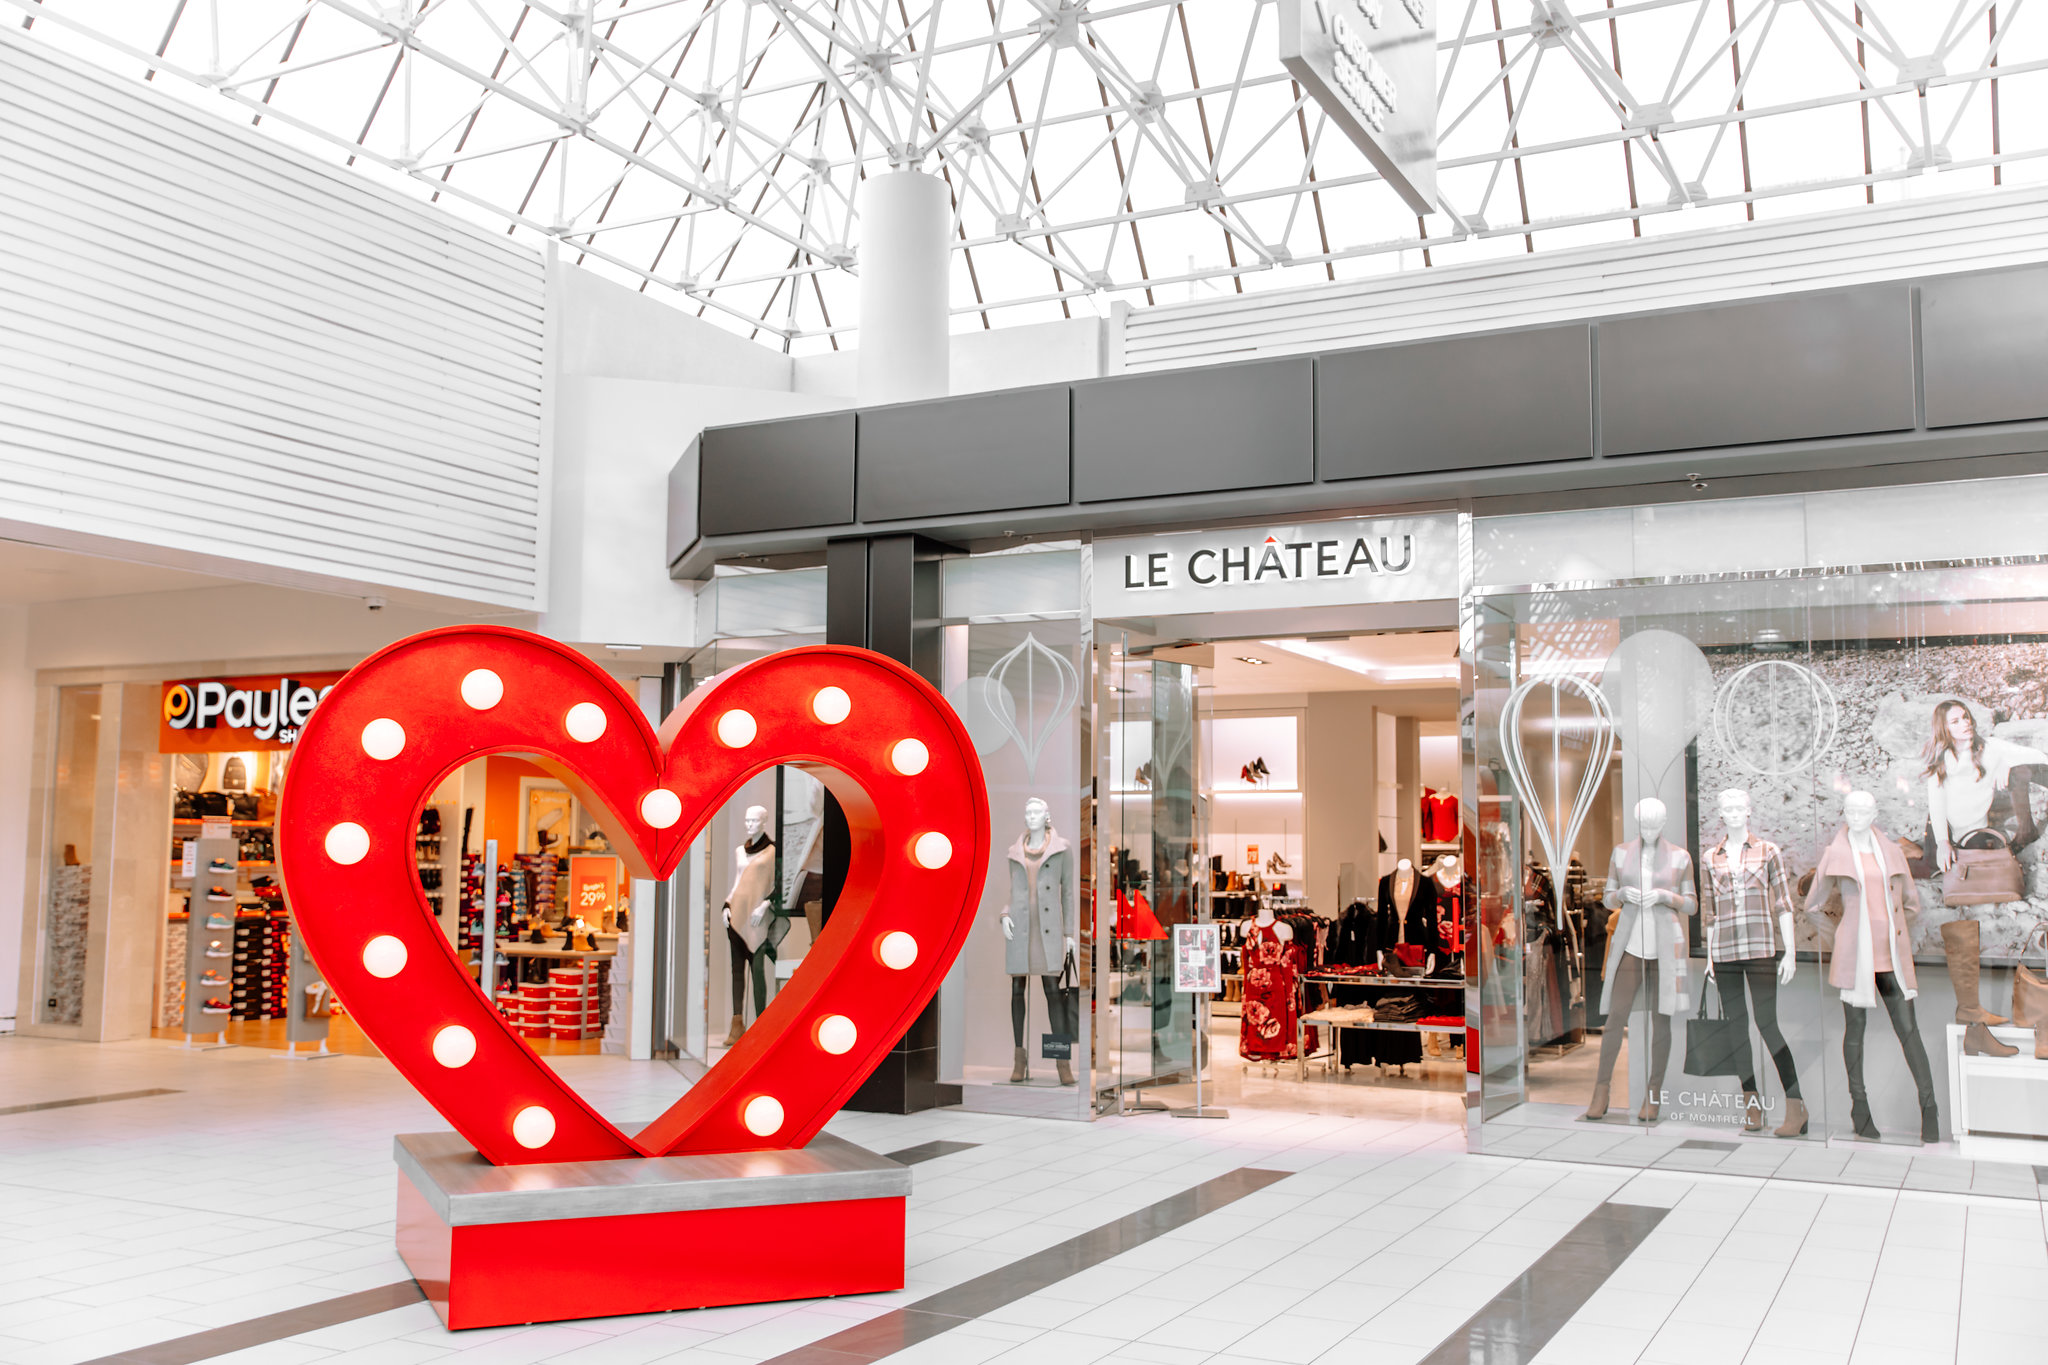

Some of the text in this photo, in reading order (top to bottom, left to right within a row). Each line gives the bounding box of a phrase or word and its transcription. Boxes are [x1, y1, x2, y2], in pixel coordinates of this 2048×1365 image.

[1333, 14, 1397, 113] CUSTOMER
[1333, 50, 1385, 132] SERVICE
[1125, 536, 1412, 588] LE CHÂTEAU
[1649, 1089, 1775, 1111] LE CHÂTEAU
[1670, 1112, 1685, 1121] OF
